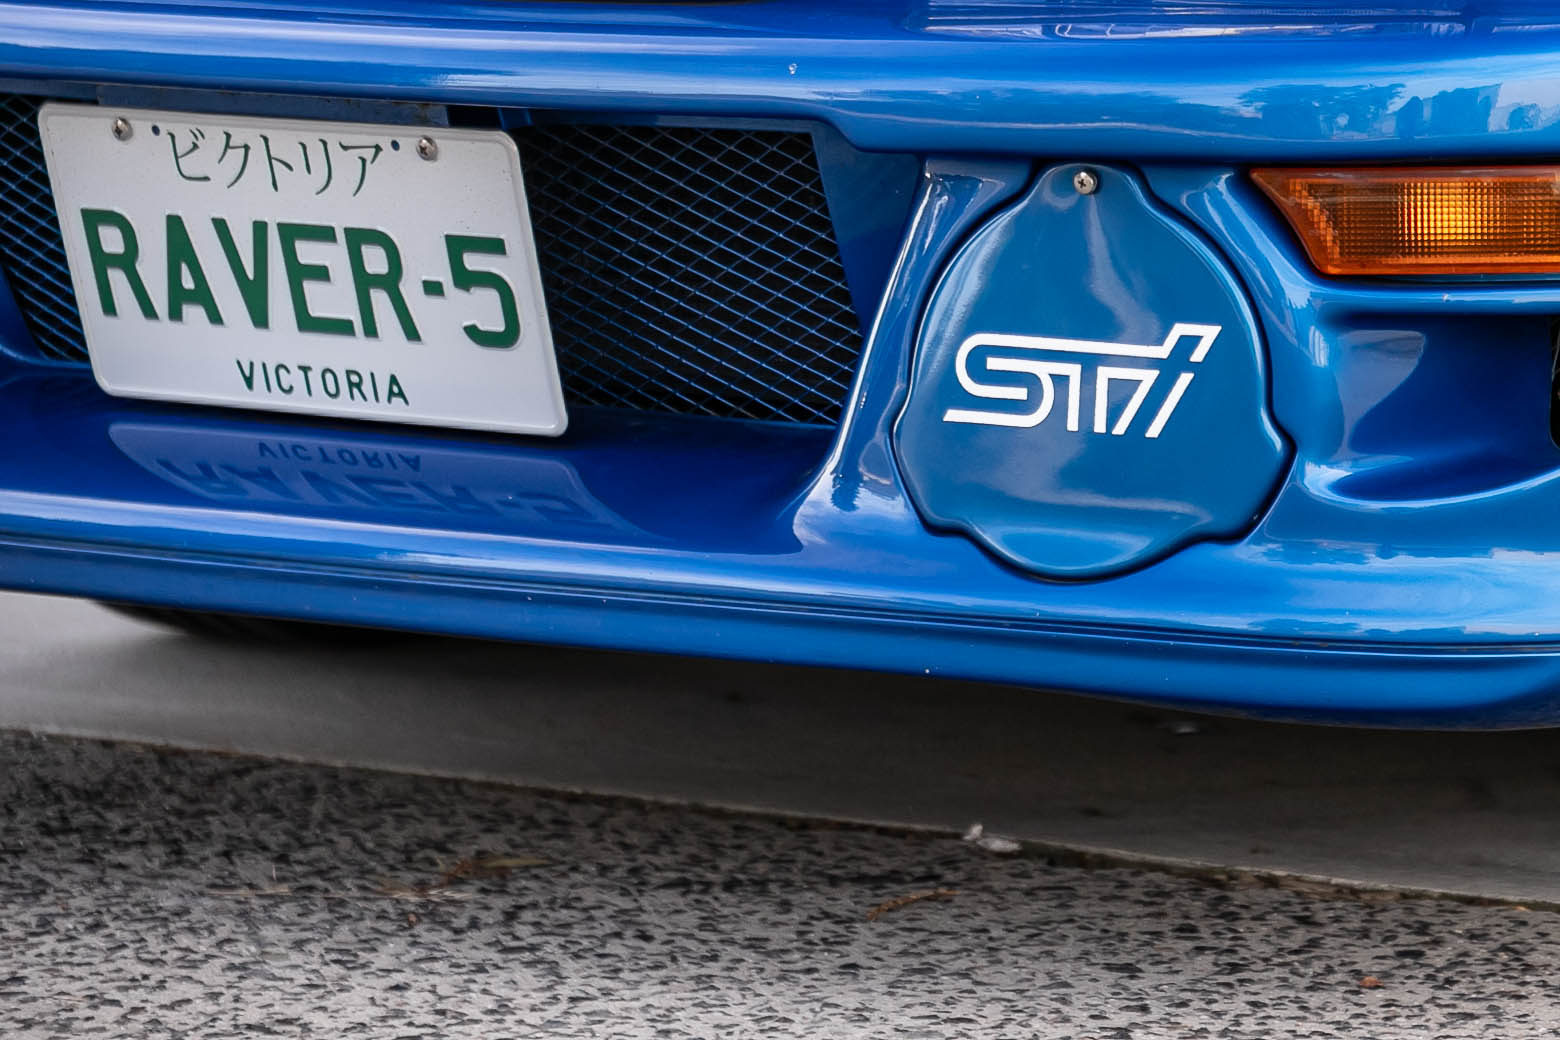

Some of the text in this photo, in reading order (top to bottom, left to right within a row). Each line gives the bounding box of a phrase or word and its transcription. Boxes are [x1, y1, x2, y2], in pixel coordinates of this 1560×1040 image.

[167, 130, 383, 196] ビクトリア
[81, 208, 521, 349] RAVER-5
[236, 360, 410, 406] VICTORIA
